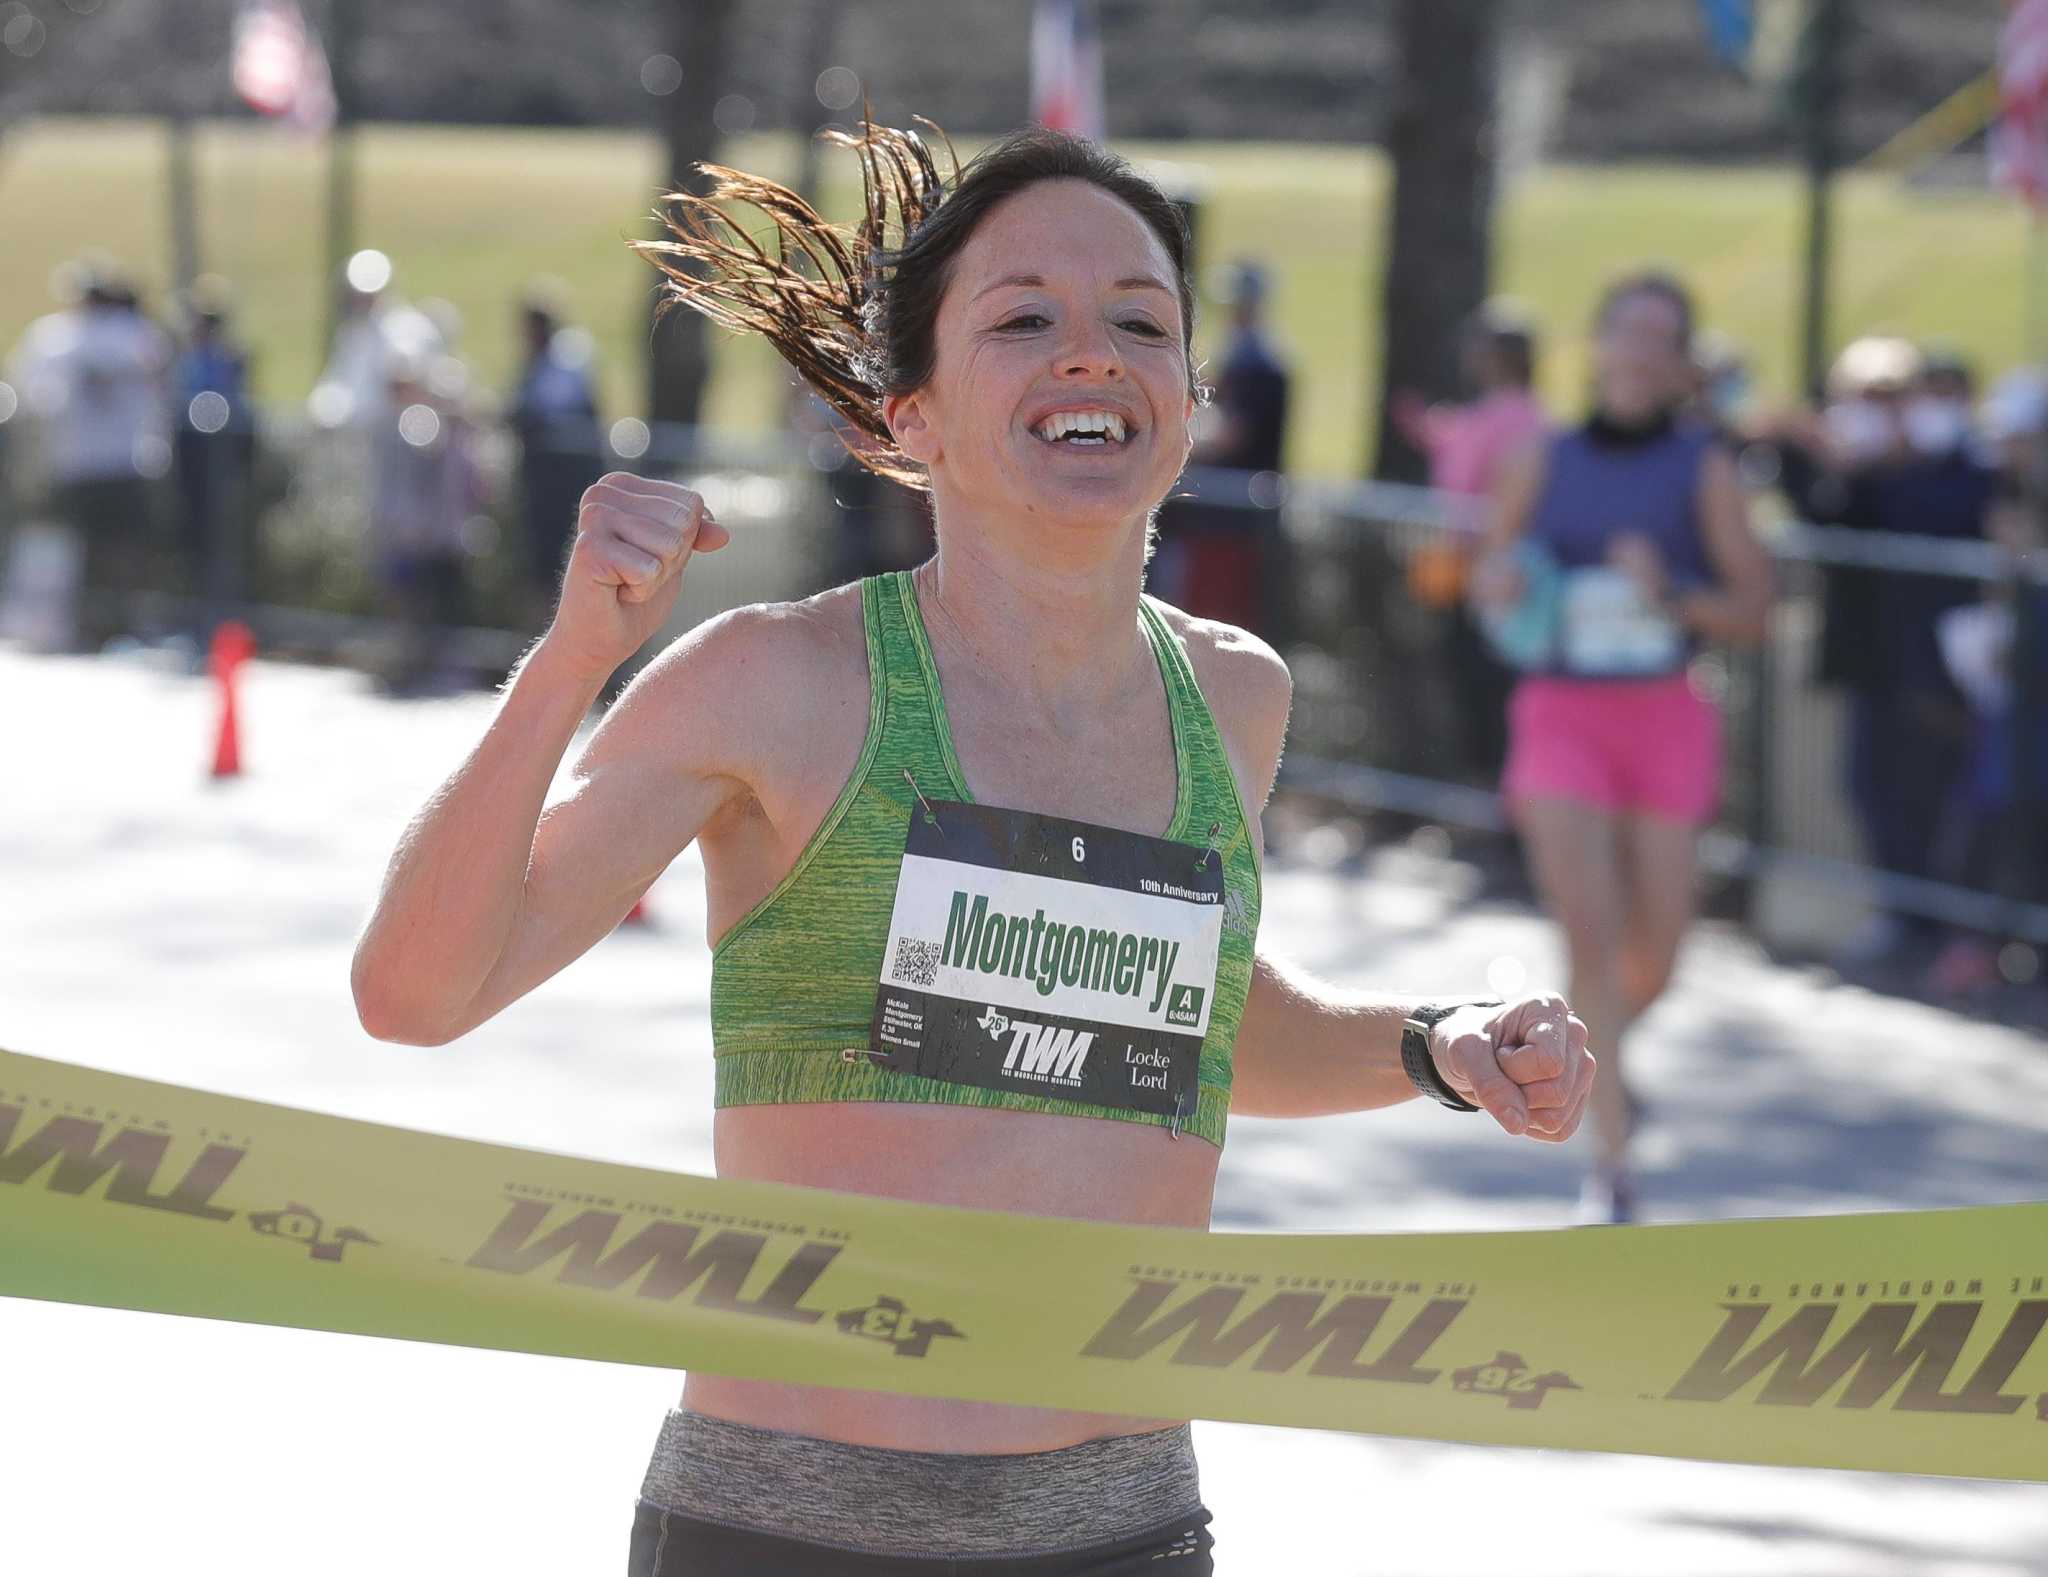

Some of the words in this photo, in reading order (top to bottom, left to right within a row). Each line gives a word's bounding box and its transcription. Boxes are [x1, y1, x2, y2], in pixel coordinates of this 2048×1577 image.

[1072, 836, 1085, 862] 6
[1140, 879, 1161, 891] 10th
[1163, 883, 1219, 902] Anniversary
[940, 890, 1180, 1012] Montgomery
[1179, 989, 1192, 1010] A
[885, 1007, 923, 1022] Montgomery
[913, 1023, 923, 1031] OK
[1003, 1020, 1094, 1081] TWM
[1124, 1044, 1170, 1069] Locke
[1001, 1068, 1012, 1077] THE
[1013, 1070, 1049, 1083] WOODLANDS
[1131, 1067, 1167, 1090] Lord
[465, 1196, 844, 1324] TWM
[1436, 1281, 1478, 1297] THE
[1787, 1279, 1983, 1298] WOODLANDS
[1077, 1278, 1472, 1384] TWM
